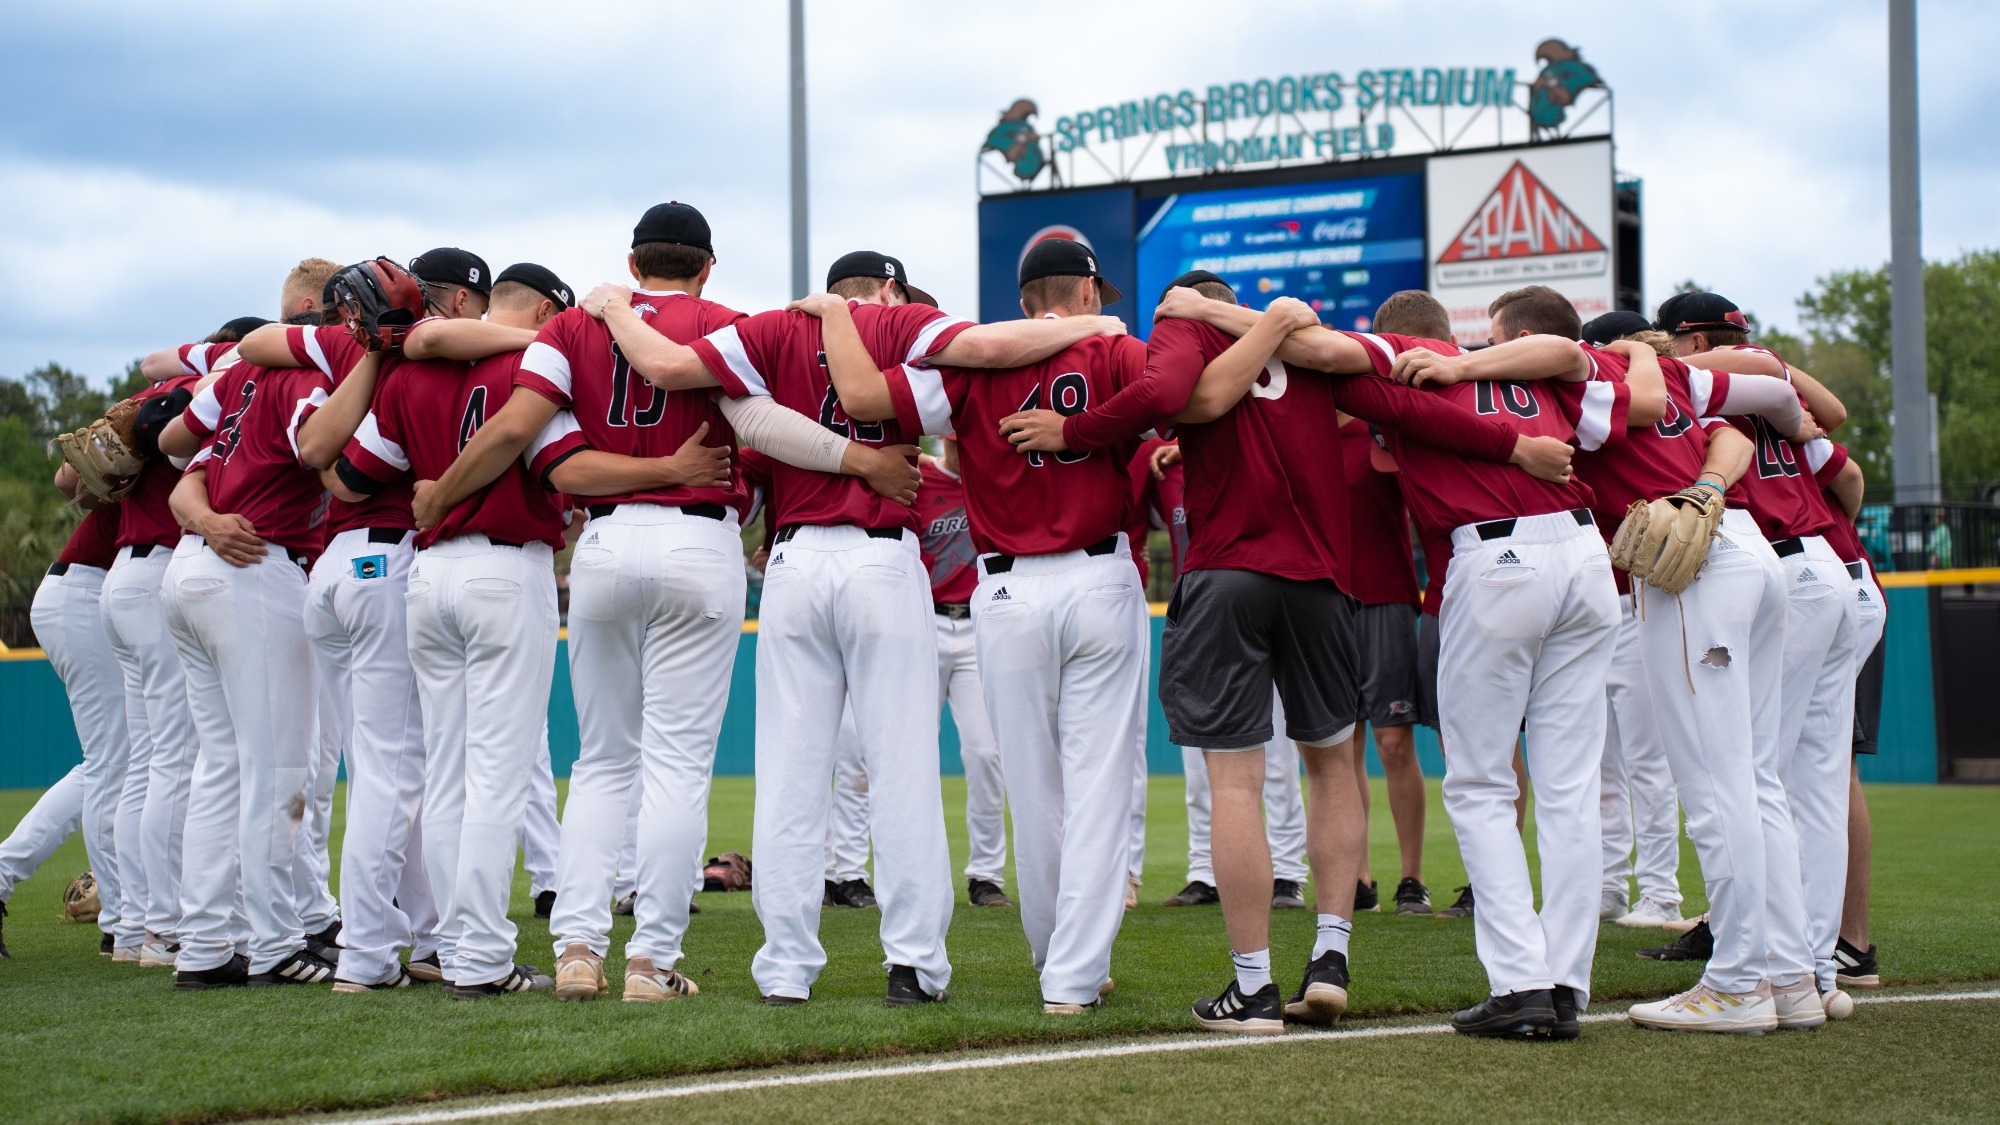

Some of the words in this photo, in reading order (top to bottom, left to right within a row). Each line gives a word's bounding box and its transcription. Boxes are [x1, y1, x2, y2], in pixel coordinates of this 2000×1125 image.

[1056, 90, 1197, 152] SPRINGS
[1207, 71, 1343, 122] BROOKS
[1357, 68, 1517, 108] STADIUM
[1165, 133, 1301, 172] VROOMAN
[1315, 123, 1395, 157] FIELD
[1460, 167, 1584, 259] SPANN
[468, 267, 480, 284] 9
[885, 262, 896, 277] 9
[1087, 256, 1096, 272] 9
